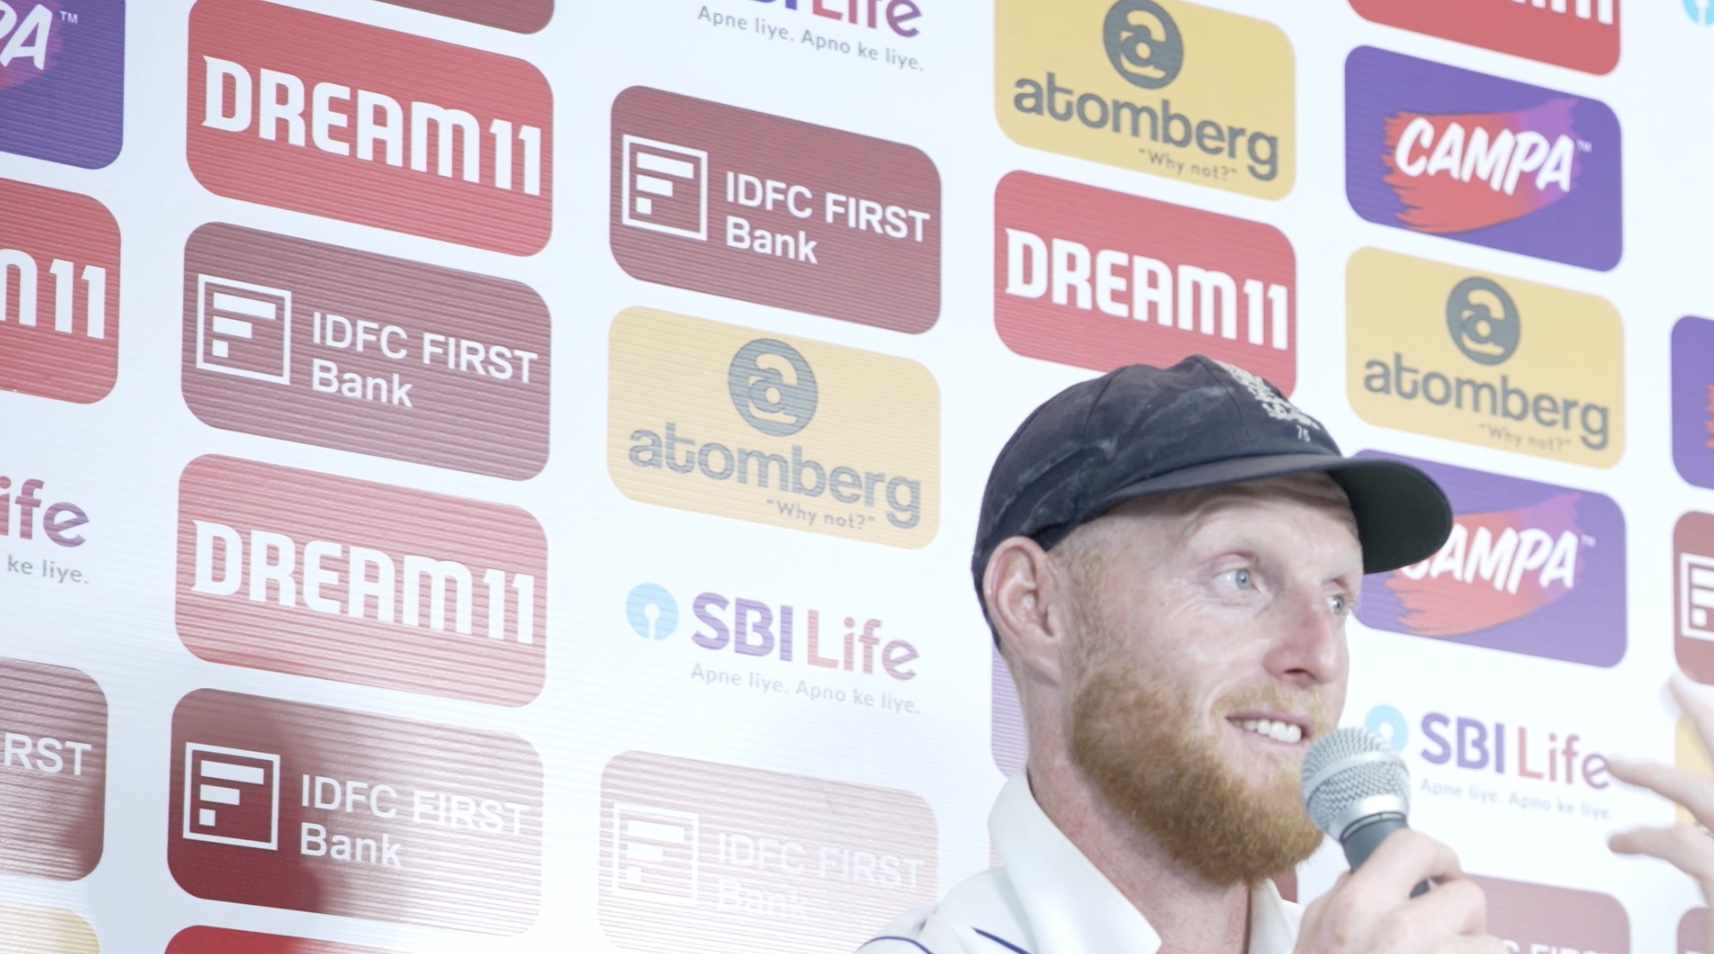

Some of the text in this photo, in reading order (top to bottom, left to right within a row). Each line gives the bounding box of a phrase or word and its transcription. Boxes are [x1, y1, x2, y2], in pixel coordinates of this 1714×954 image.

[698, 5, 748, 31] Apne
[755, 18, 794, 42] liye.
[801, 29, 851, 54] Apno
[858, 42, 878, 61] ke
[886, 47, 924, 71] liye.
[202, 54, 542, 196] DREAM11
[1013, 71, 1279, 182] atomberg
[1395, 117, 1575, 196] CAMPA
[726, 170, 931, 243] IDFC FIRST
[726, 216, 818, 265] Bank
[1005, 227, 1289, 350] DREAM11
[311, 358, 412, 408] Bank
[312, 311, 538, 383] IDFC FIRST
[1364, 353, 1609, 452] atomberg
[629, 421, 921, 529] atomberg
[7, 554, 90, 586] ke liye.
[191, 519, 535, 645] DREAM11
[691, 592, 921, 682] SBI Life
[690, 662, 921, 716] Apne liye. Apno ke liye.
[1420, 711, 1611, 790] SBI Life
[301, 773, 530, 837] IDFC FIRST
[300, 822, 402, 869] Bank
[821, 848, 924, 888] FIRST
